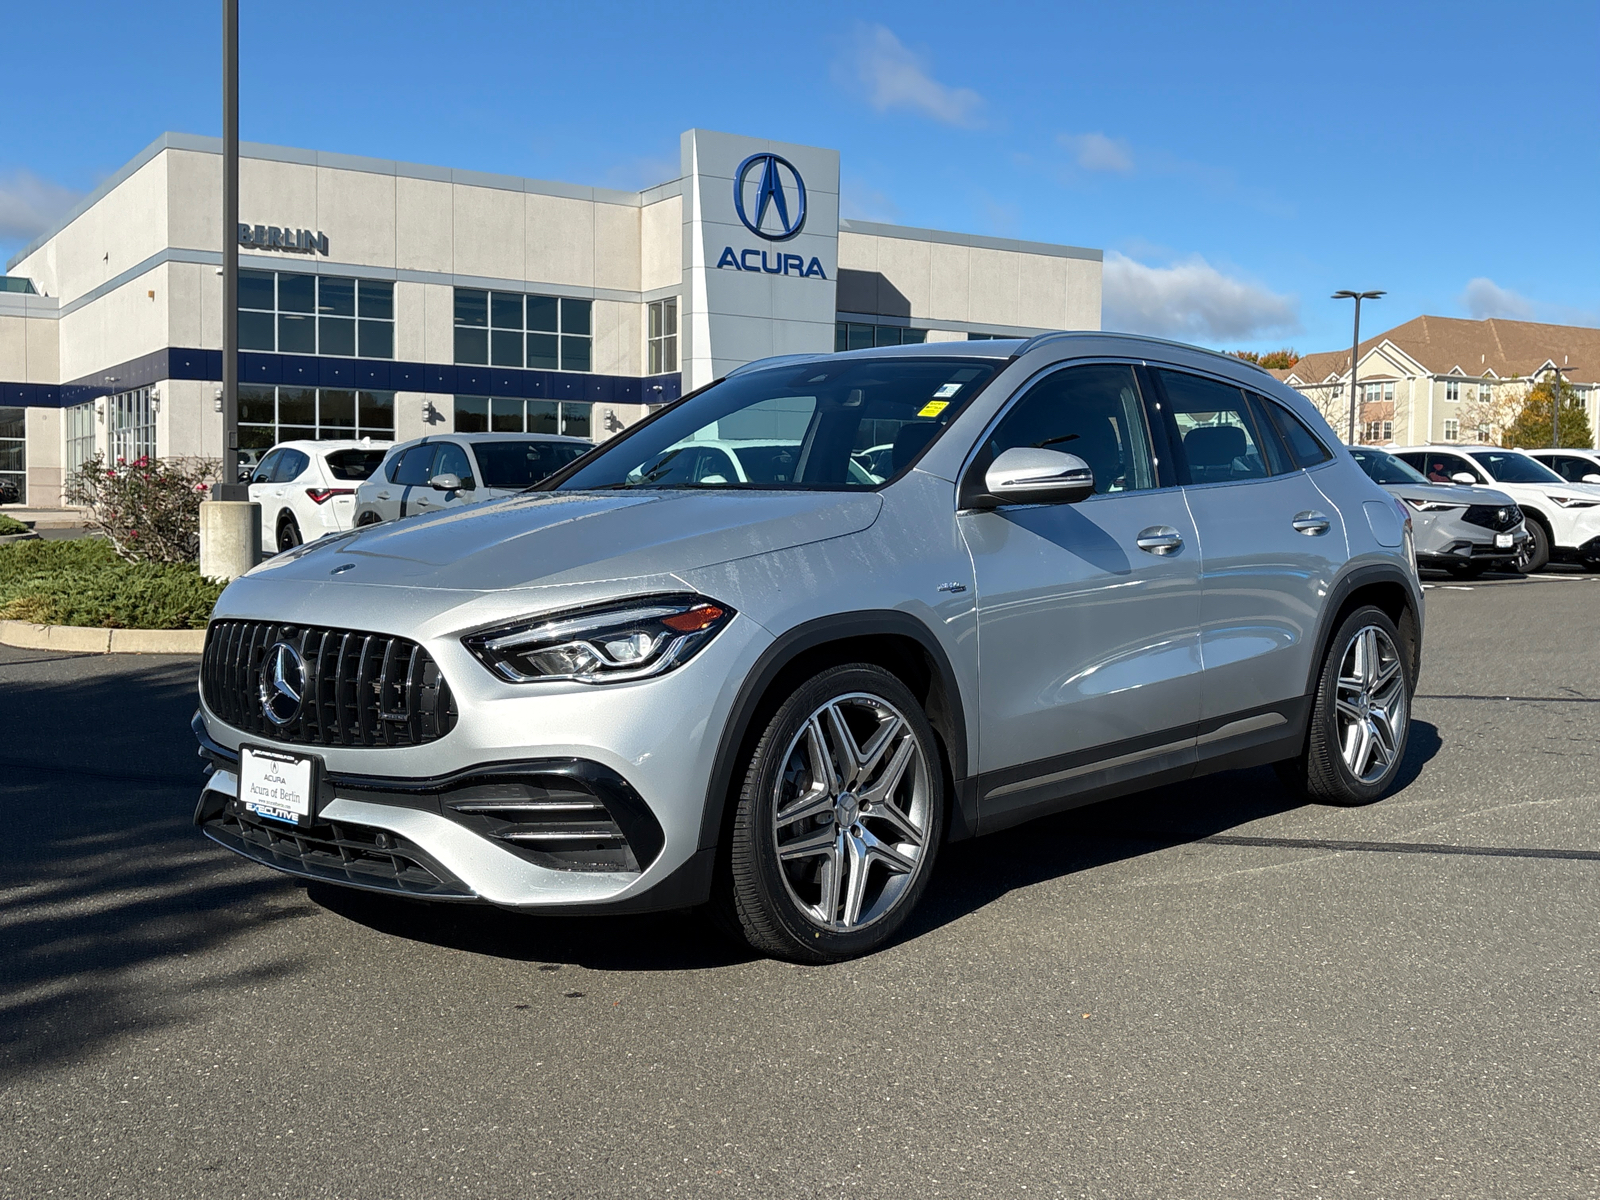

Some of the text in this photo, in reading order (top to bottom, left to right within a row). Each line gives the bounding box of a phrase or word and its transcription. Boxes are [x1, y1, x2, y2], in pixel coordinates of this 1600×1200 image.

[238, 223, 325, 252] BERLIN
[716, 246, 827, 280] ACURA
[264, 774, 286, 784] ACURA
[250, 782, 300, 803] Acura of Berlin
[246, 802, 299, 822] EXECUTIVE
